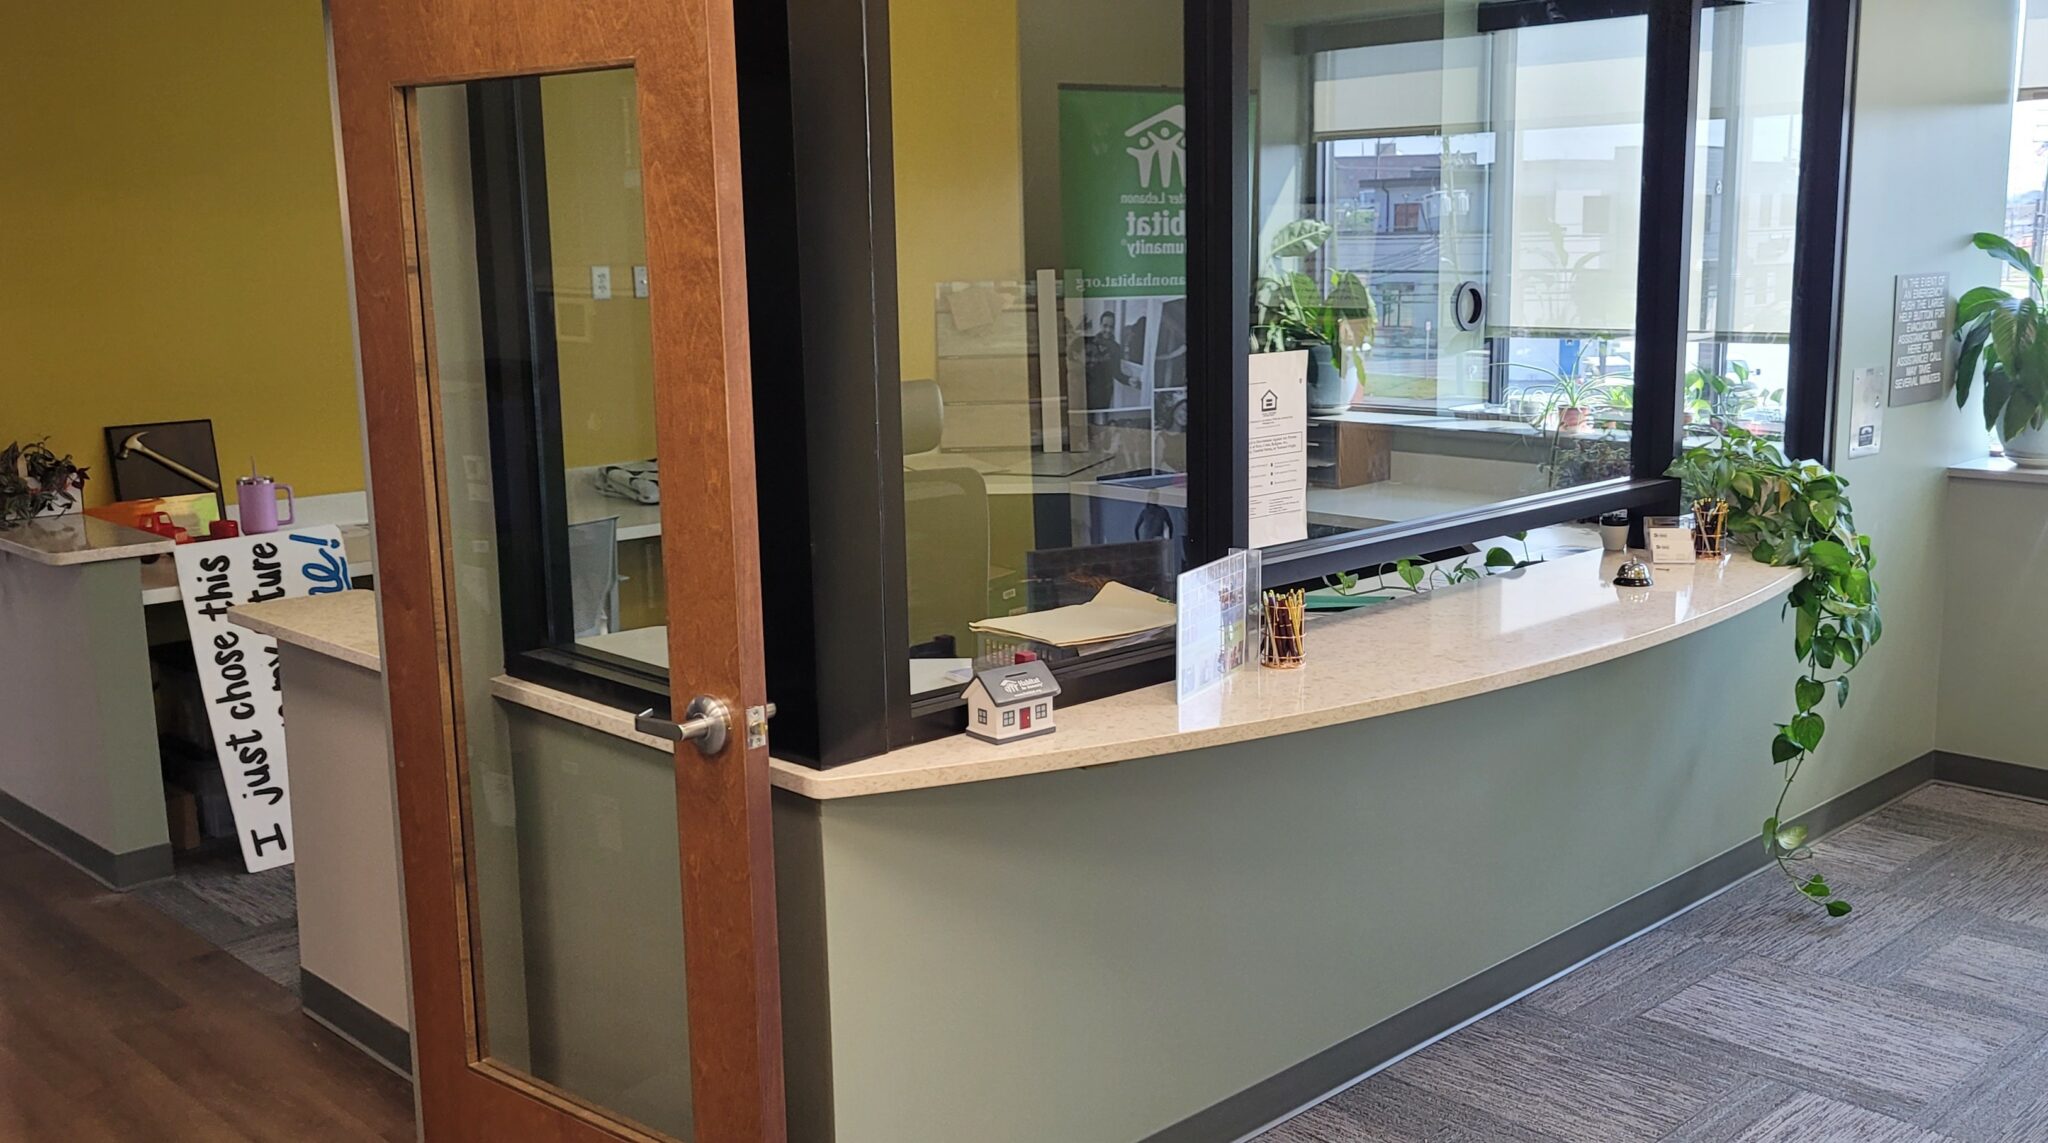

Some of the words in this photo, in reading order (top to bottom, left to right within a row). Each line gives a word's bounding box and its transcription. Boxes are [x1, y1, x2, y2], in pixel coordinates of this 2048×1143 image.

[195, 555, 234, 621] this
[247, 542, 286, 603] ture
[214, 631, 256, 720] chose
[226, 728, 283, 806] just
[251, 823, 287, 857] I
